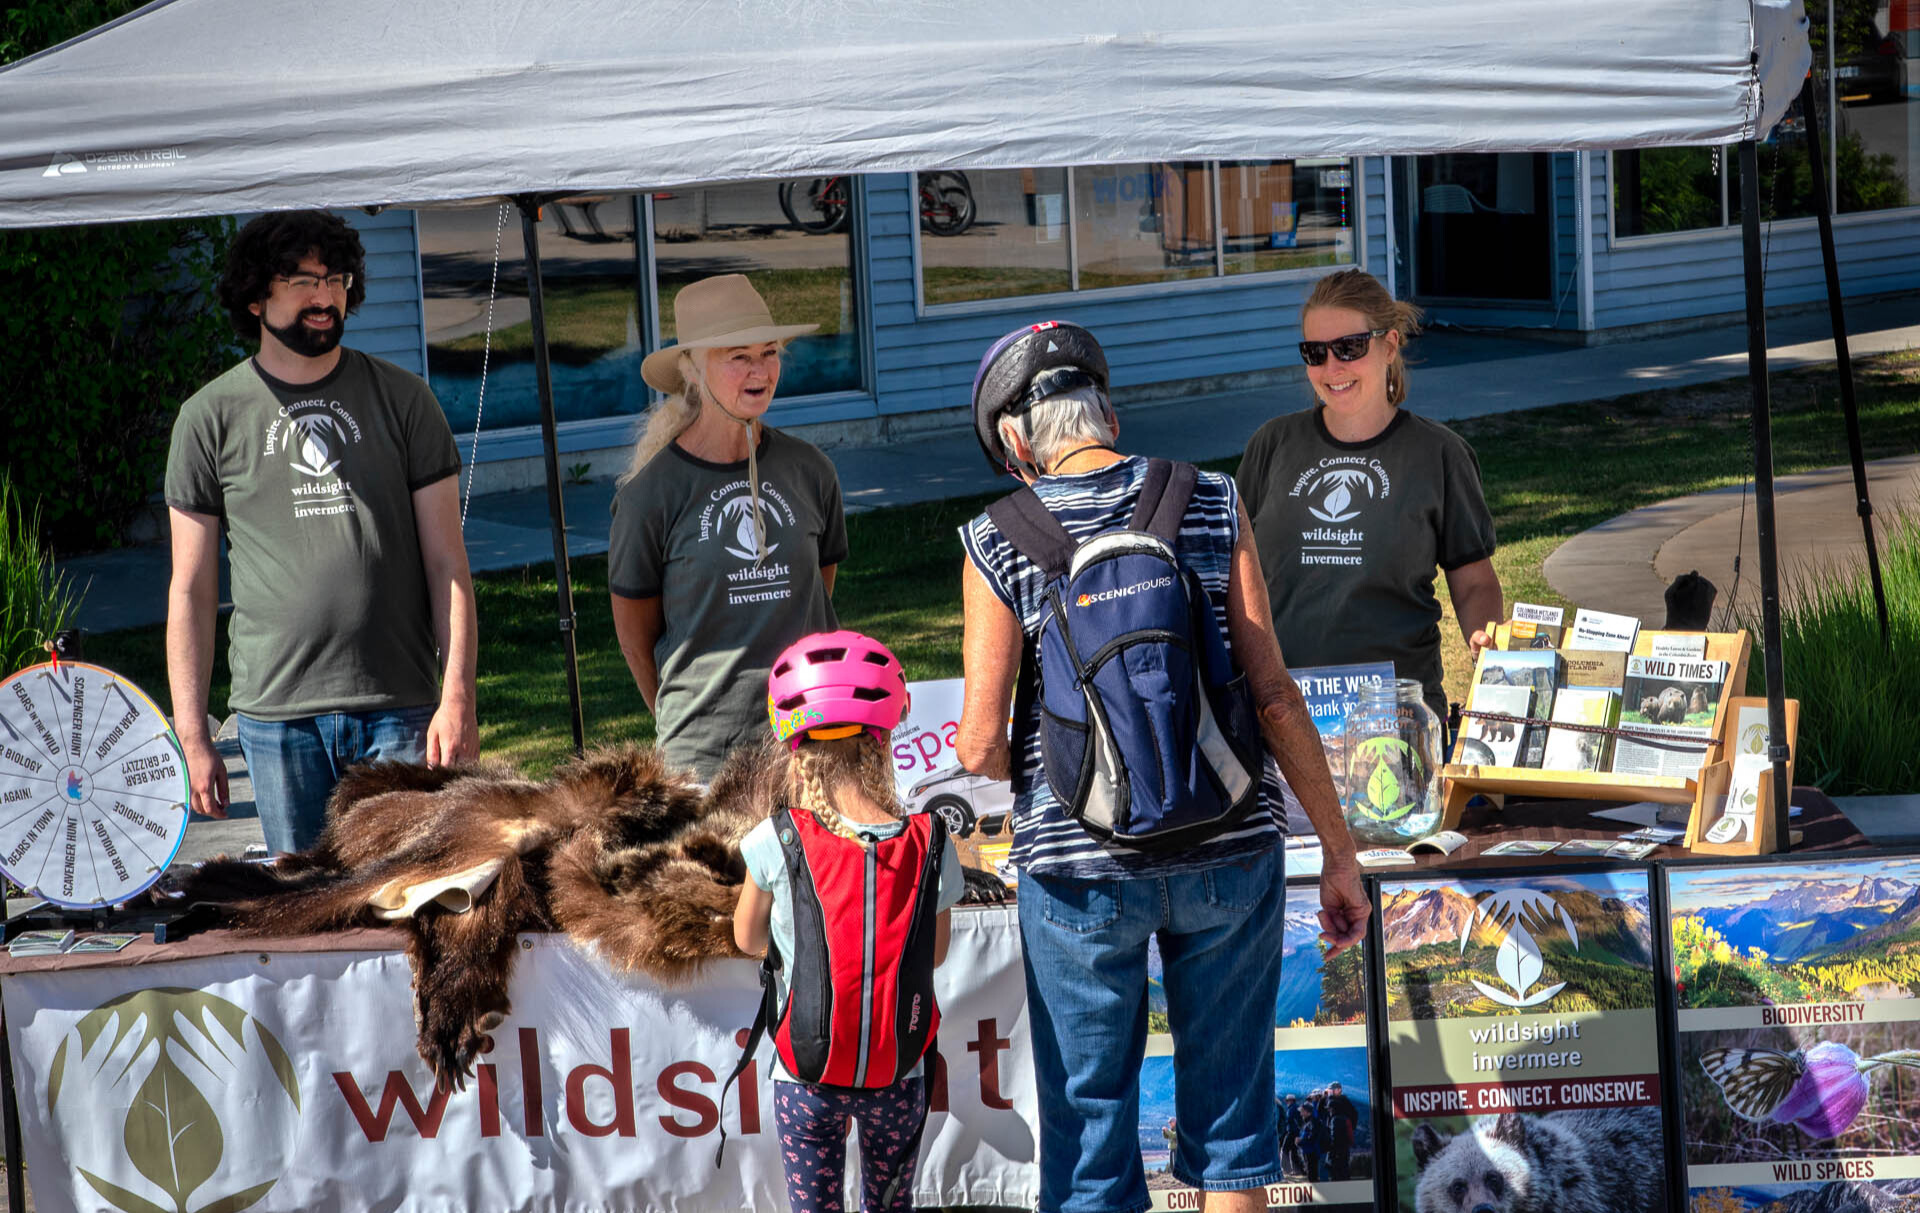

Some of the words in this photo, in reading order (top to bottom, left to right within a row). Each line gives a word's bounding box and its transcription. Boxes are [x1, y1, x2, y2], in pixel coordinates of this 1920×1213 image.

[97, 164, 131, 172] OUTDOOR
[133, 162, 176, 170] EQUIPMENT
[263, 419, 282, 456] Inspire.
[278, 399, 327, 418] Connect.
[329, 400, 362, 443] Conserve.
[291, 478, 352, 497] wildsight
[1288, 467, 1319, 497] Inspire.
[1319, 456, 1367, 468] Connect.
[1369, 458, 1390, 499] Conserve.
[294, 503, 356, 518] invermere
[698, 503, 715, 542] Inspire.
[710, 480, 752, 502] Connec
[1302, 527, 1364, 545] wildsight
[1301, 552, 1362, 565] invermere
[727, 563, 790, 582] wildsight
[729, 589, 791, 605] invermere
[1645, 660, 1676, 677] WILD
[1679, 663, 1713, 679] TIMES
[1314, 677, 1342, 696] THE
[72, 676, 85, 731] SCAVENGER
[1306, 699, 1340, 717] hank
[12, 681, 35, 712] BEARS
[29, 711, 38, 721] IN
[34, 719, 46, 735] THE
[42, 730, 60, 756] WILD
[119, 707, 140, 730] BEAR
[71, 732, 82, 758] HUNT
[95, 725, 125, 761] BIOLOGY
[5, 748, 43, 774] BIOLOGY
[121, 755, 160, 774] GRIZZLY?
[125, 770, 149, 787] BEAR
[150, 766, 176, 782] BLACK
[3, 787, 33, 804] AGAIN!
[113, 801, 145, 826] CHOICE
[7, 839, 31, 867] BEARS
[26, 829, 39, 843] IN
[33, 808, 55, 833] TOWN
[66, 816, 78, 841] HUNT
[91, 819, 117, 858] BIOLOGY
[145, 819, 168, 840] YOUR
[63, 843, 76, 897] SCAVENGER
[111, 856, 130, 882] BEAR
[1762, 1003, 1865, 1025] BIODIVERSITY
[1468, 1018, 1582, 1045] wildsight
[1472, 1050, 1583, 1073] invermere
[332, 1018, 1014, 1143] wildsit
[1403, 1089, 1473, 1113] INSPIRE.
[1478, 1085, 1556, 1108] CONNECT.
[1560, 1080, 1651, 1103] CONSERVE.
[1772, 1163, 1812, 1182] WILD
[1816, 1160, 1875, 1180] SPACES
